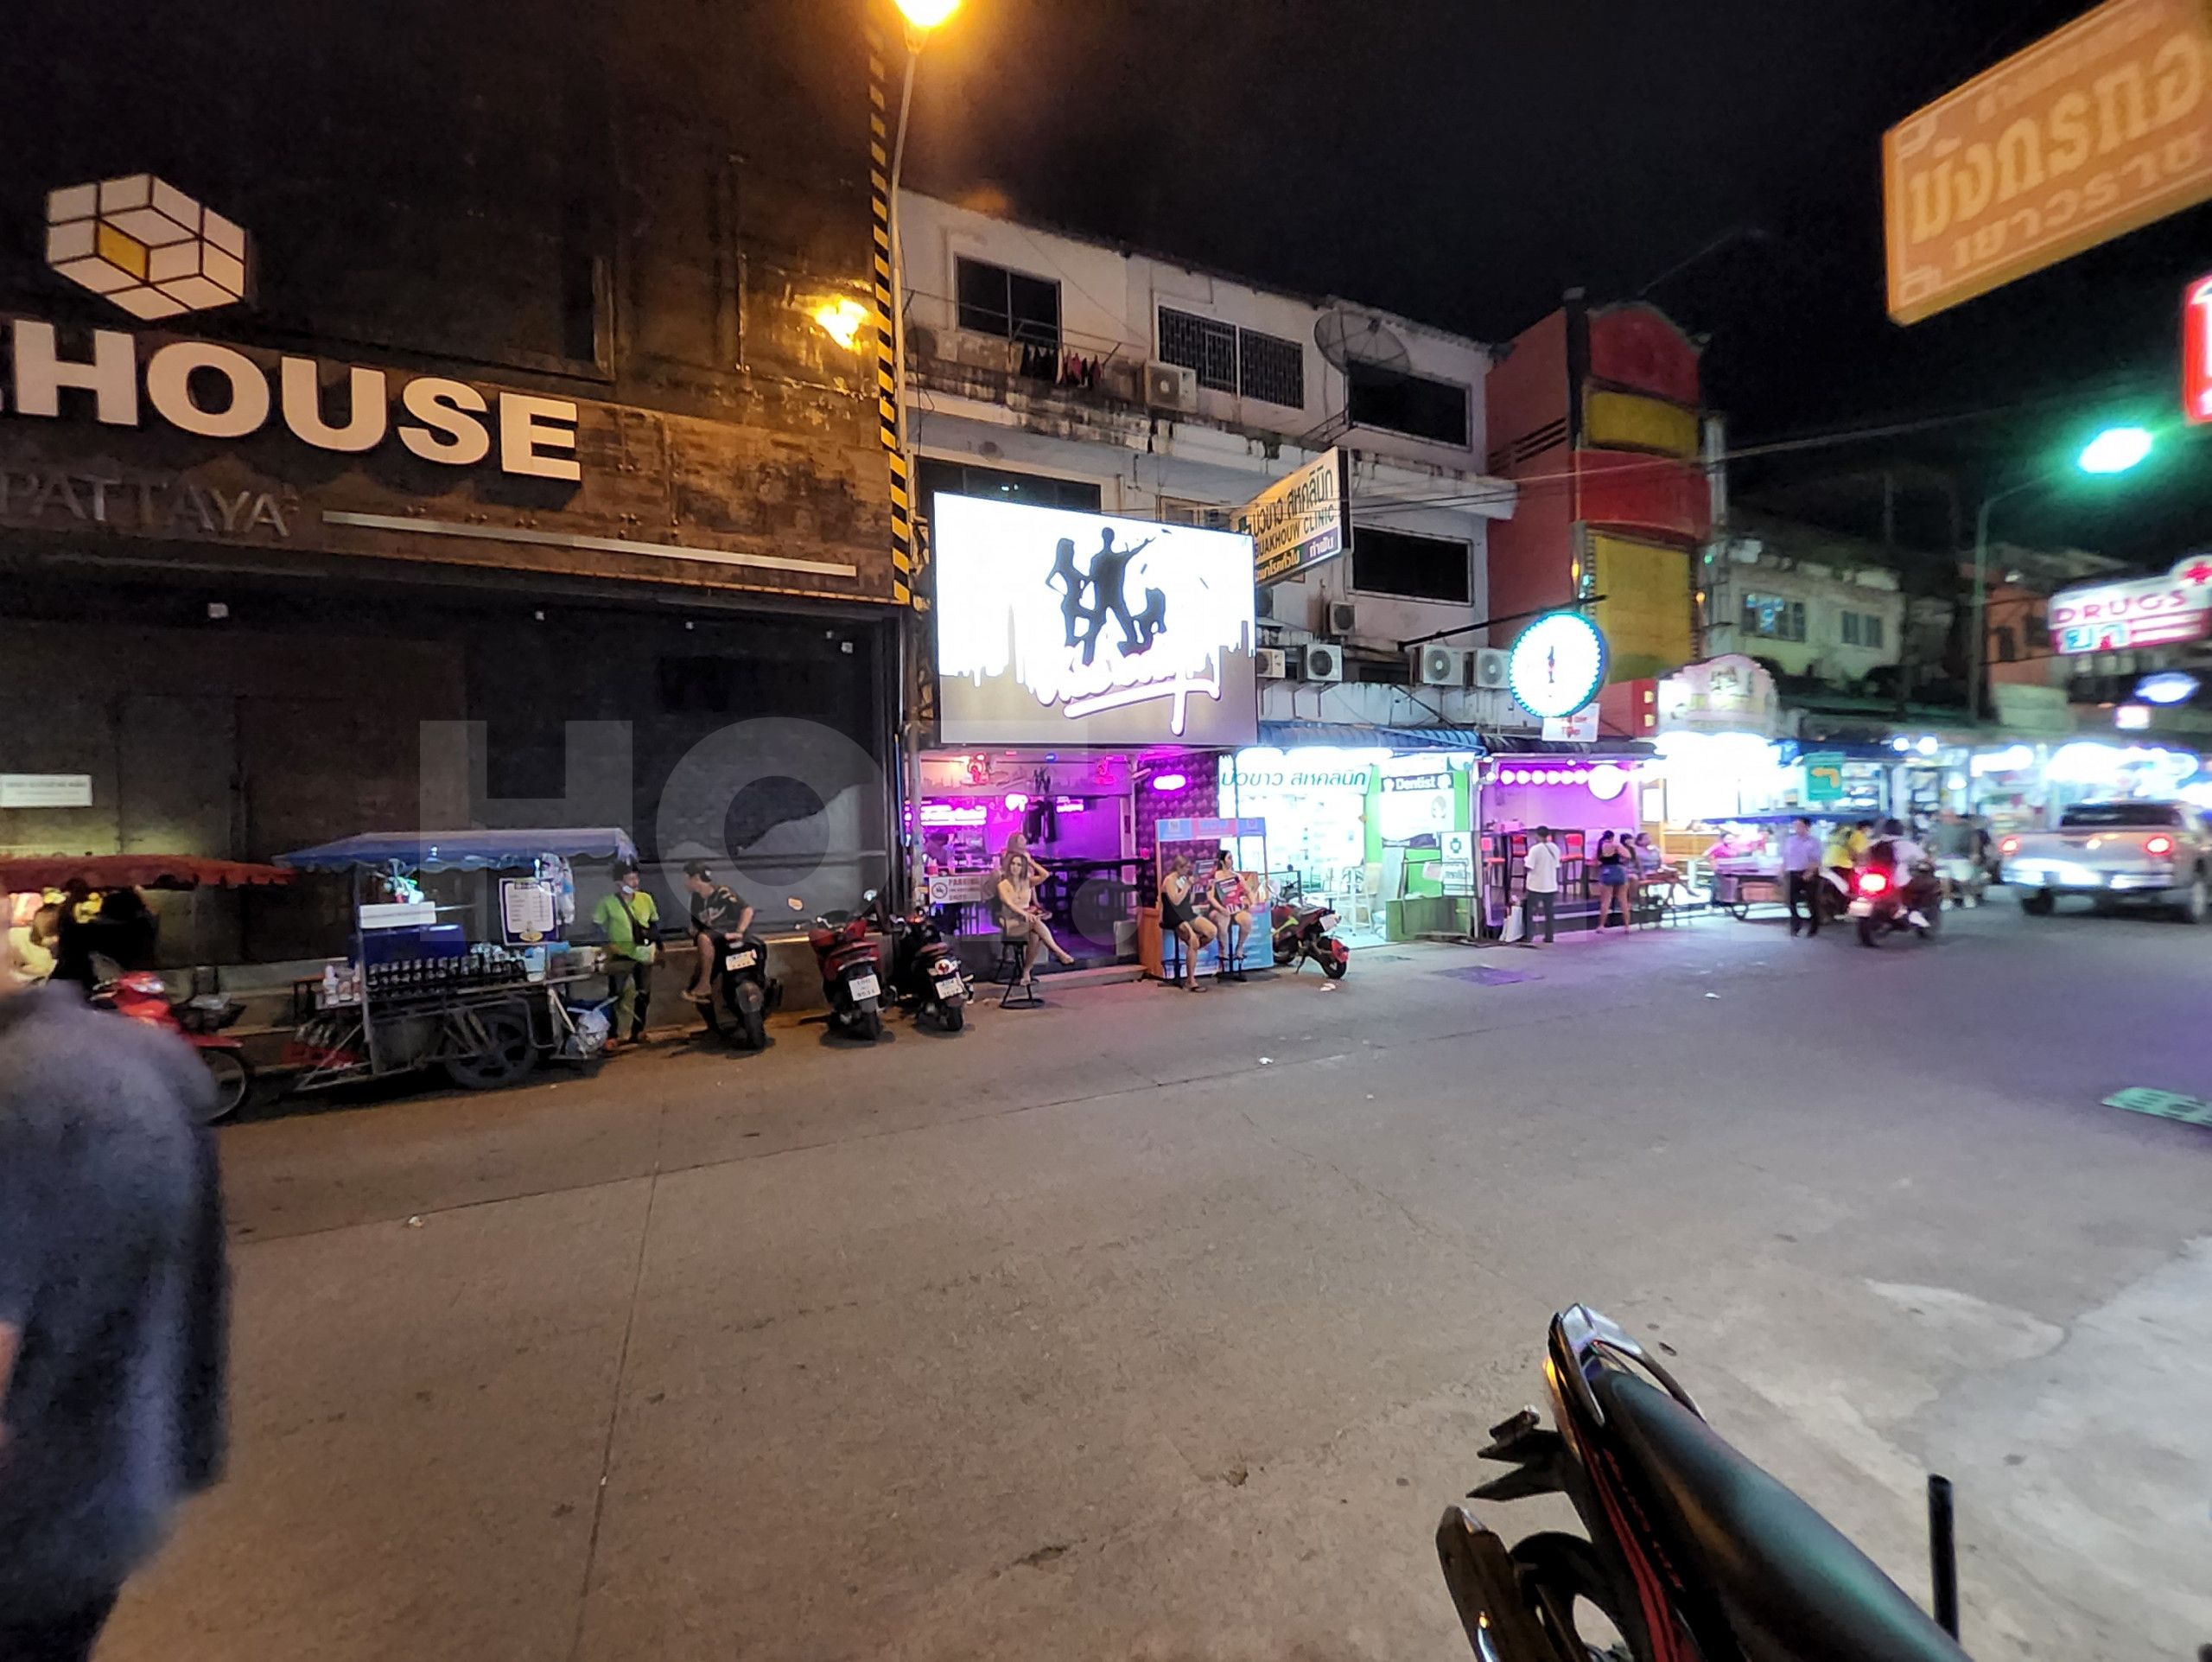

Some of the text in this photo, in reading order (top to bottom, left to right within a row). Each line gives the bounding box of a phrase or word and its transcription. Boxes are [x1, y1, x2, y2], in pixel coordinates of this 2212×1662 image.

[0, 319, 582, 482] HOUSE
[0, 471, 291, 538] PATTAYA
[1303, 504, 1335, 533] CLINIC
[2053, 589, 2189, 624] DRUGS
[1395, 776, 1436, 791] Dentist
